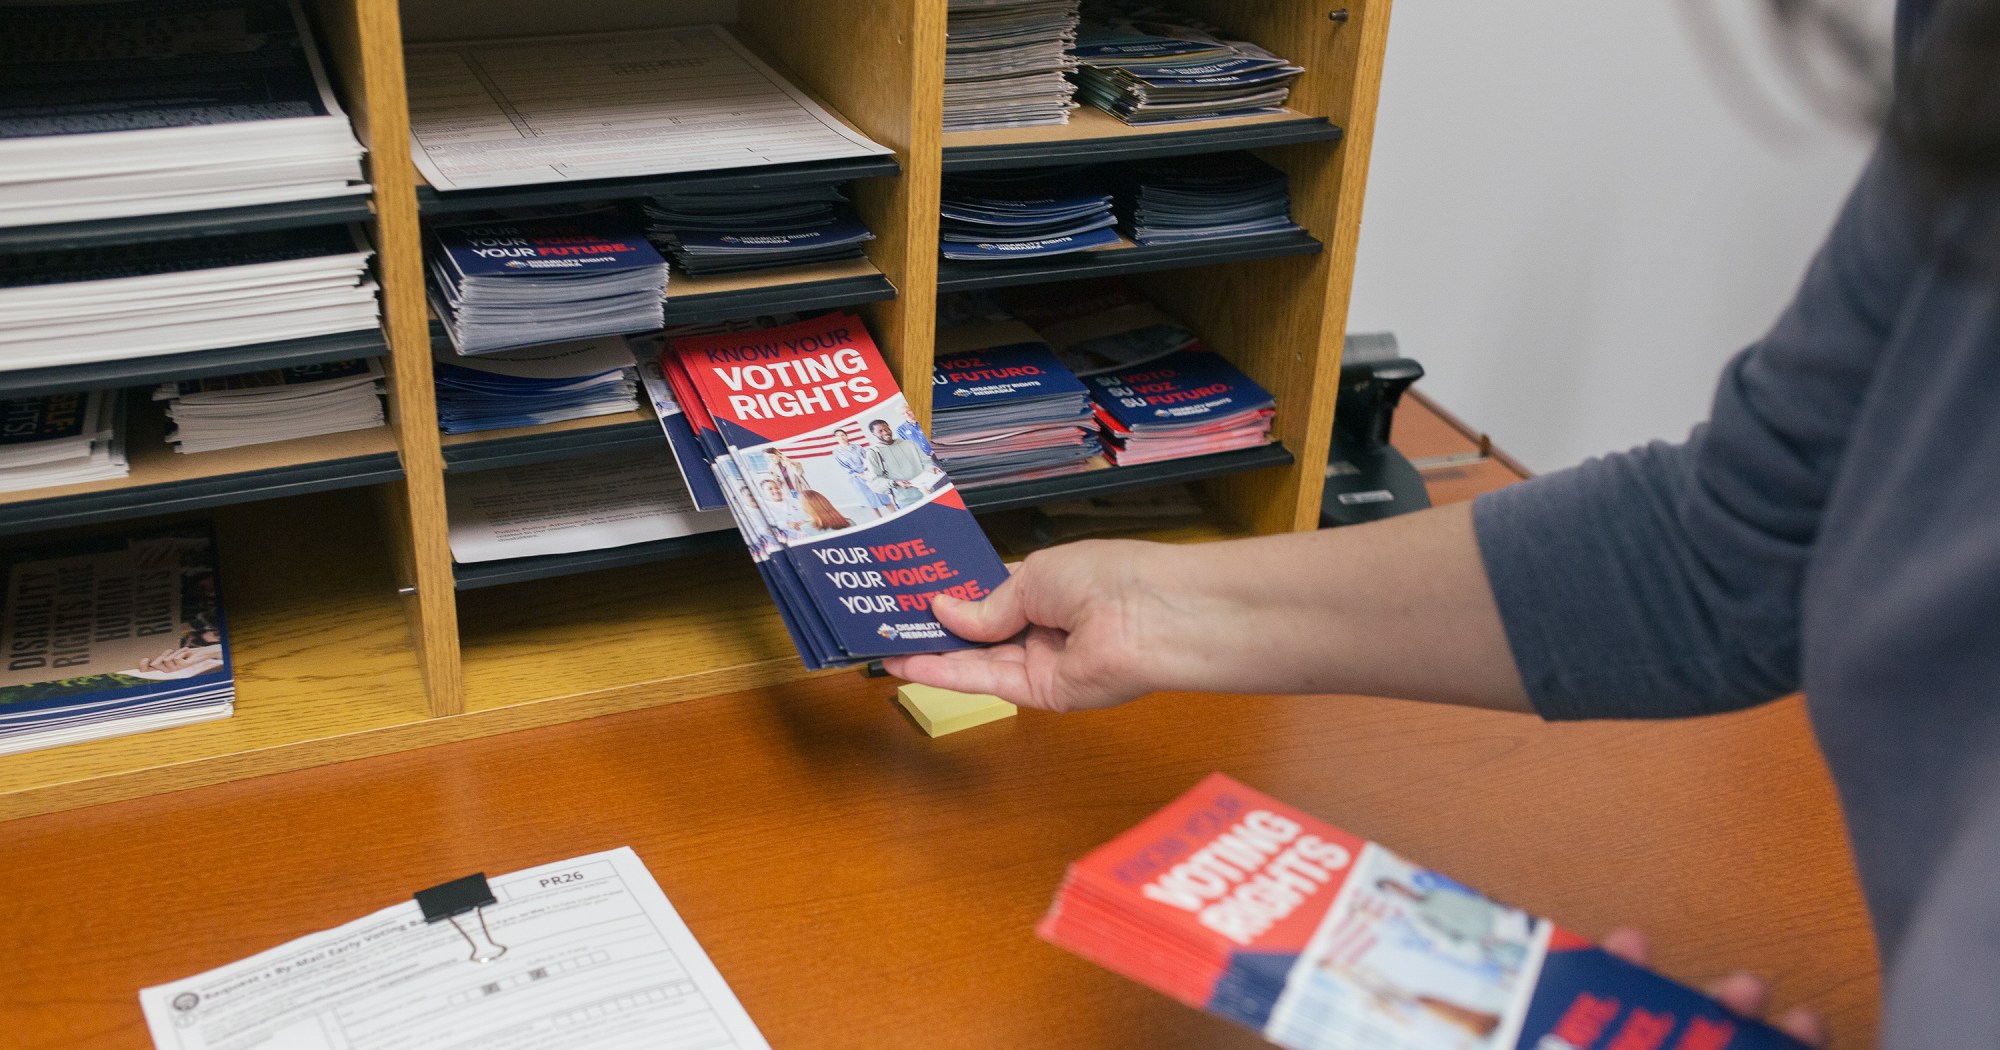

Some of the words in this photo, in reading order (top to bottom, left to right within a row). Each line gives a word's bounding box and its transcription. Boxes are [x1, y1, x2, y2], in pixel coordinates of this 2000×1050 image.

[467, 238, 528, 247] YOUR
[472, 248, 537, 258] YOUR
[537, 243, 636, 257] FUTURE.
[705, 342, 781, 363] KNOW
[783, 328, 853, 355] YOUR
[712, 348, 868, 392] VOTING
[939, 357, 991, 370] VOZ.
[932, 374, 949, 386] U
[949, 365, 1046, 383] FUTURO.
[1096, 376, 1122, 386] SU
[969, 383, 1015, 392] DISABILITY
[1013, 381, 1041, 389] RIGHTS
[973, 388, 1016, 396] NEBRASKA
[1108, 386, 1134, 397] SU
[1133, 381, 1182, 395] VOZ.
[1120, 397, 1147, 408] SU
[1146, 383, 1234, 405] FUTURO.
[728, 376, 879, 420] RIGHTS
[812, 547, 872, 565] YOUR
[869, 538, 936, 563] VOTE.
[826, 571, 886, 589] YOUR
[882, 560, 959, 587] VOICE.
[94, 576, 133, 643] HUMAN
[135, 570, 173, 637] RIGHTS
[839, 595, 900, 614] YOUR
[9, 573, 54, 671] DISABILITY
[895, 622, 942, 633] DISABILITY
[52, 600, 93, 668] RIGHTS
[899, 629, 947, 640] NEBRASKA
[1141, 809, 1303, 913] VOTING
[539, 871, 584, 888] PR26
[1197, 833, 1353, 945] RIGHTS
[364, 924, 408, 943] Voting
